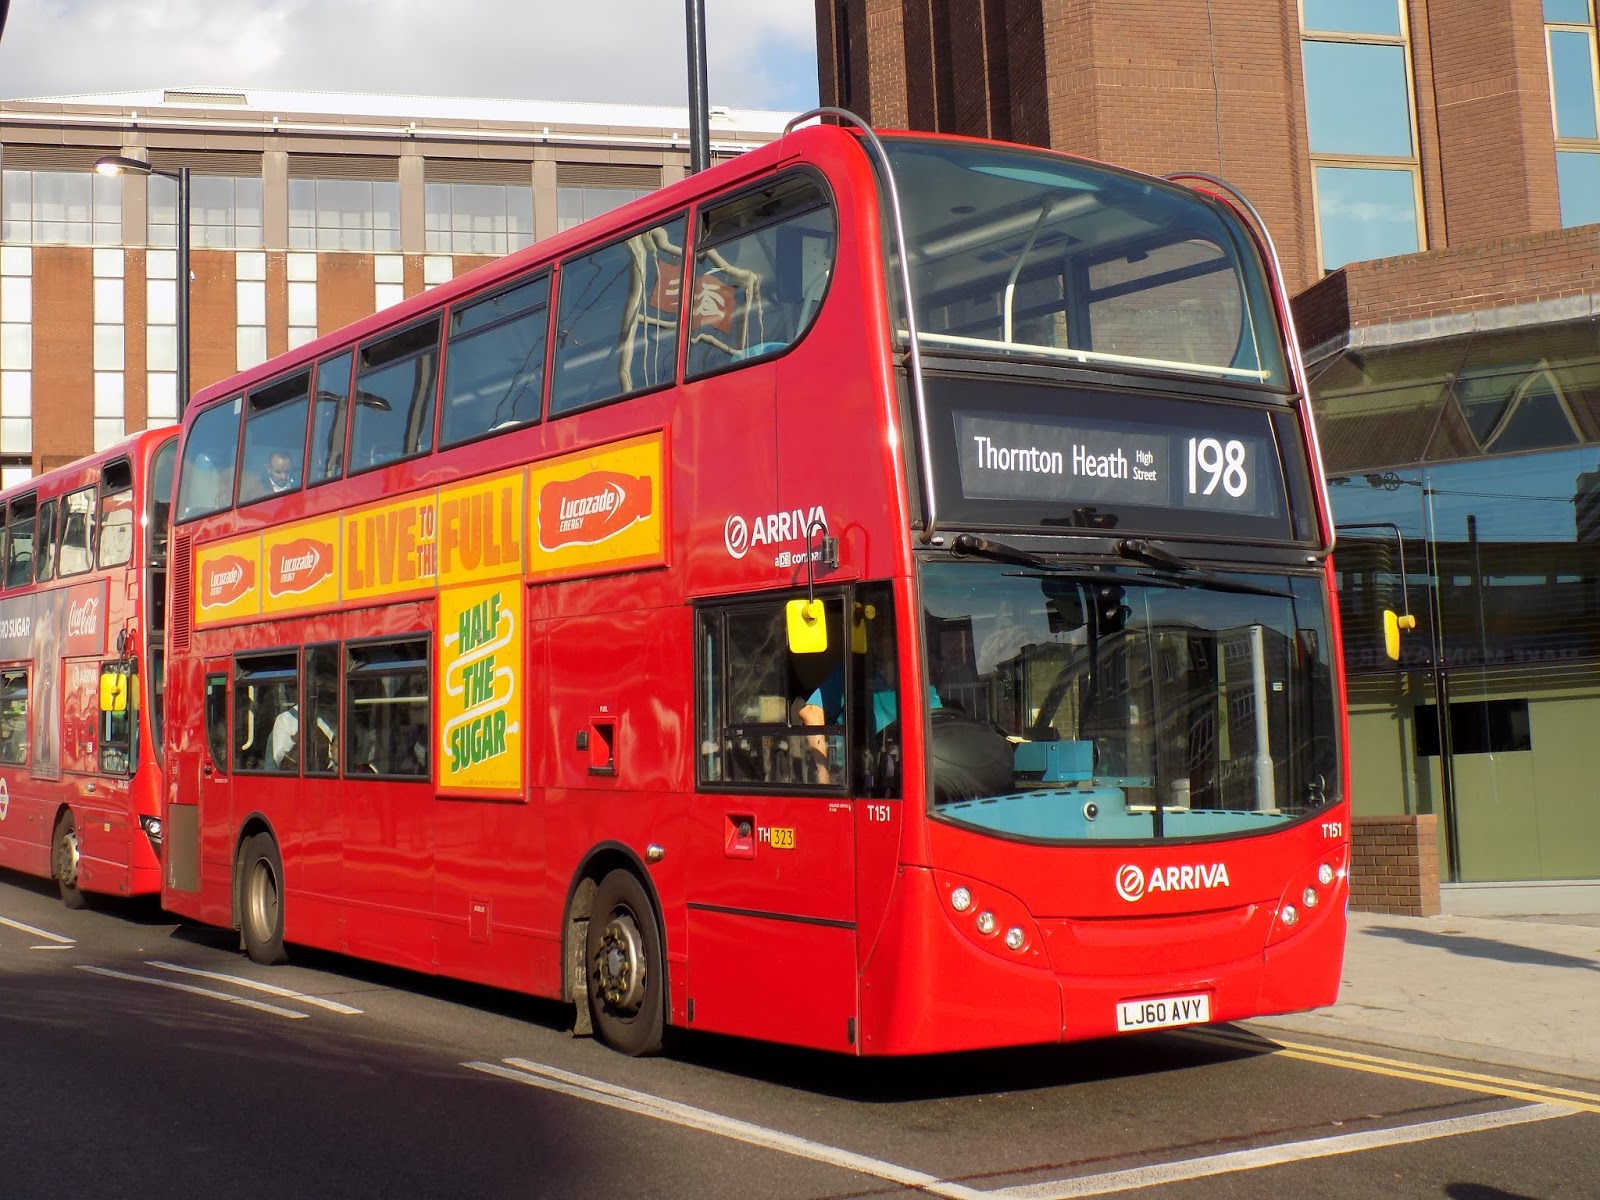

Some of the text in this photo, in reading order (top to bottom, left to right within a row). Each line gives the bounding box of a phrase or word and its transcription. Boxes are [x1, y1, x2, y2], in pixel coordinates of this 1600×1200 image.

[974, 436, 1128, 479] Thornton Heath
[1136, 450, 1154, 467] High
[1187, 437, 1247, 498] 198
[1133, 467, 1157, 482] Street
[560, 488, 615, 520] Lucozade
[419, 504, 435, 541] TO
[441, 486, 520, 574] FULL
[559, 517, 584, 533] ENERGY
[751, 505, 830, 547] ARRIVA
[281, 551, 314, 574] Lucozade
[347, 506, 417, 591] LIVE
[210, 567, 239, 588] Lucozade
[9, 616, 31, 638] SUGAR
[459, 592, 502, 656] HALF
[462, 655, 496, 711] THE
[451, 709, 508, 774] SUGAR
[867, 805, 891, 822] T151
[757, 827, 794, 846] TH 323
[1321, 822, 1342, 839] T151
[1147, 863, 1230, 893] ARRIVA
[1123, 999, 1201, 1026] LJ60 AVY
